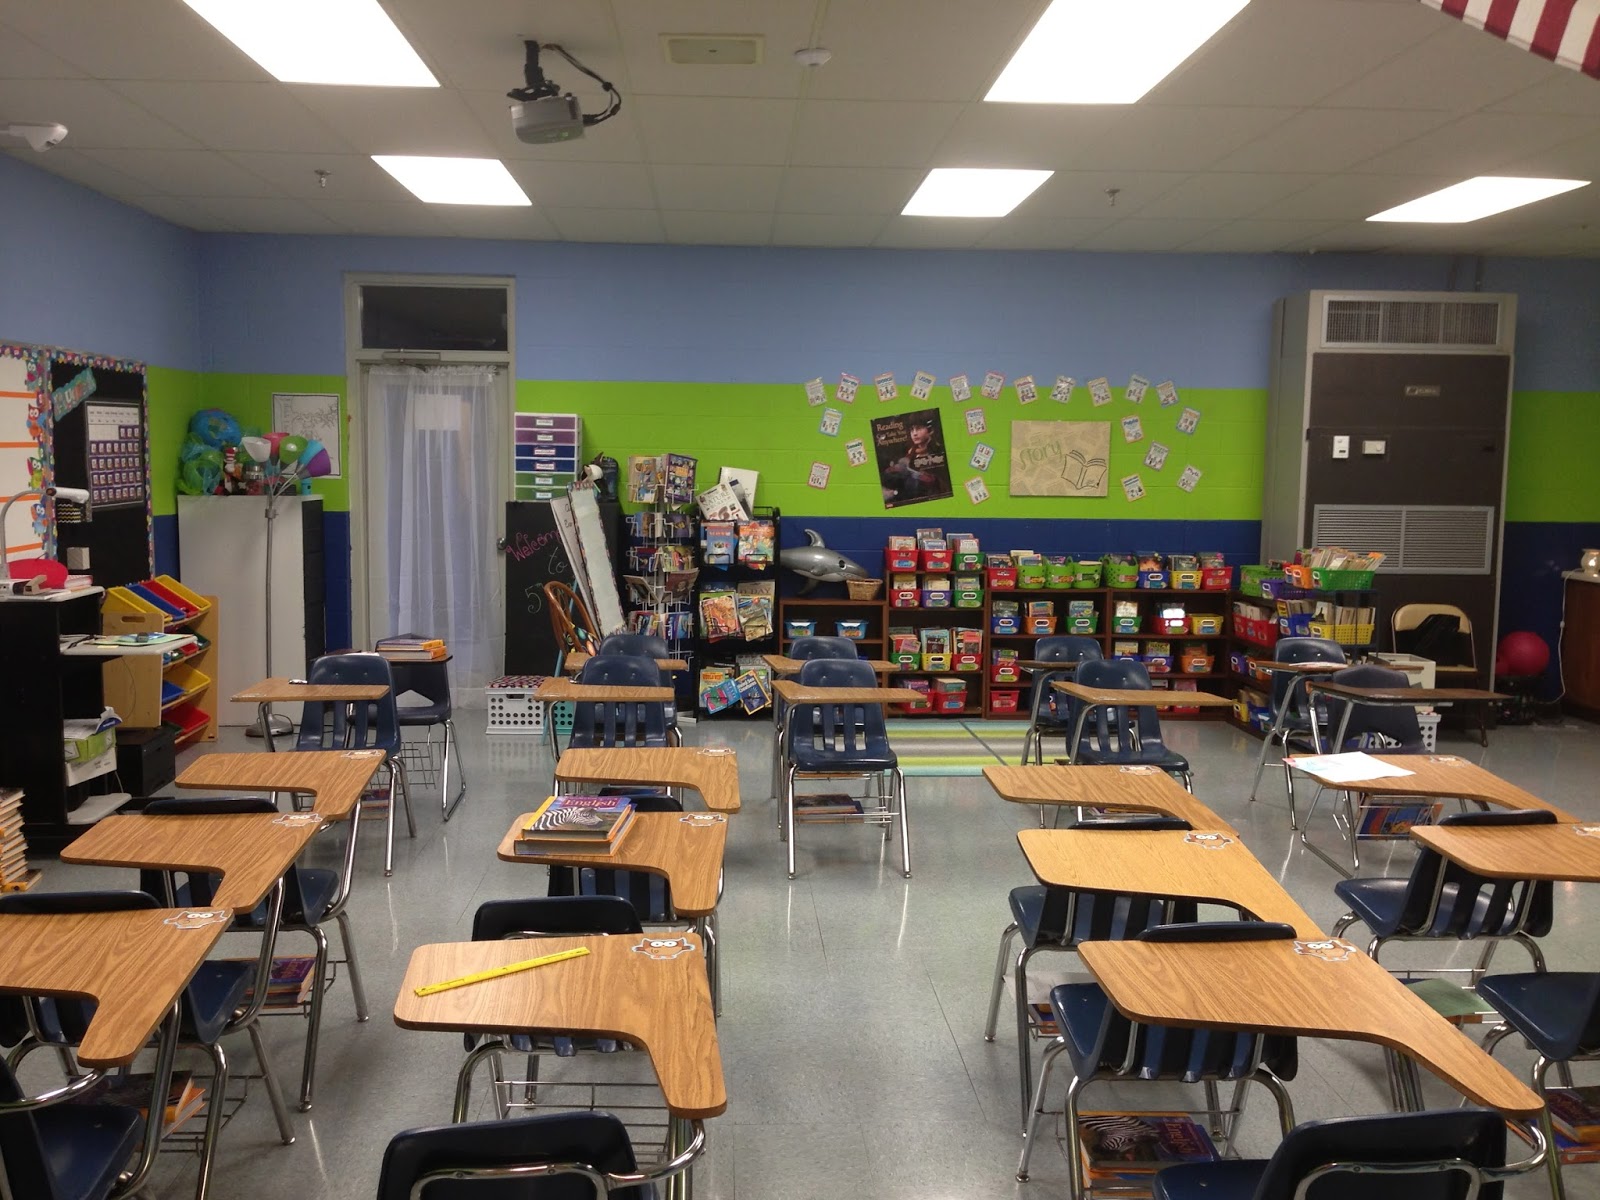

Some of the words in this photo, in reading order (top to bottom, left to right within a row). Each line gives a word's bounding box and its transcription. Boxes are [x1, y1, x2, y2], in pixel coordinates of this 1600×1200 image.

[876, 421, 904, 431] Reading
[505, 530, 561, 562] Welcom
[548, 546, 568, 575] to
[565, 799, 617, 807] English
